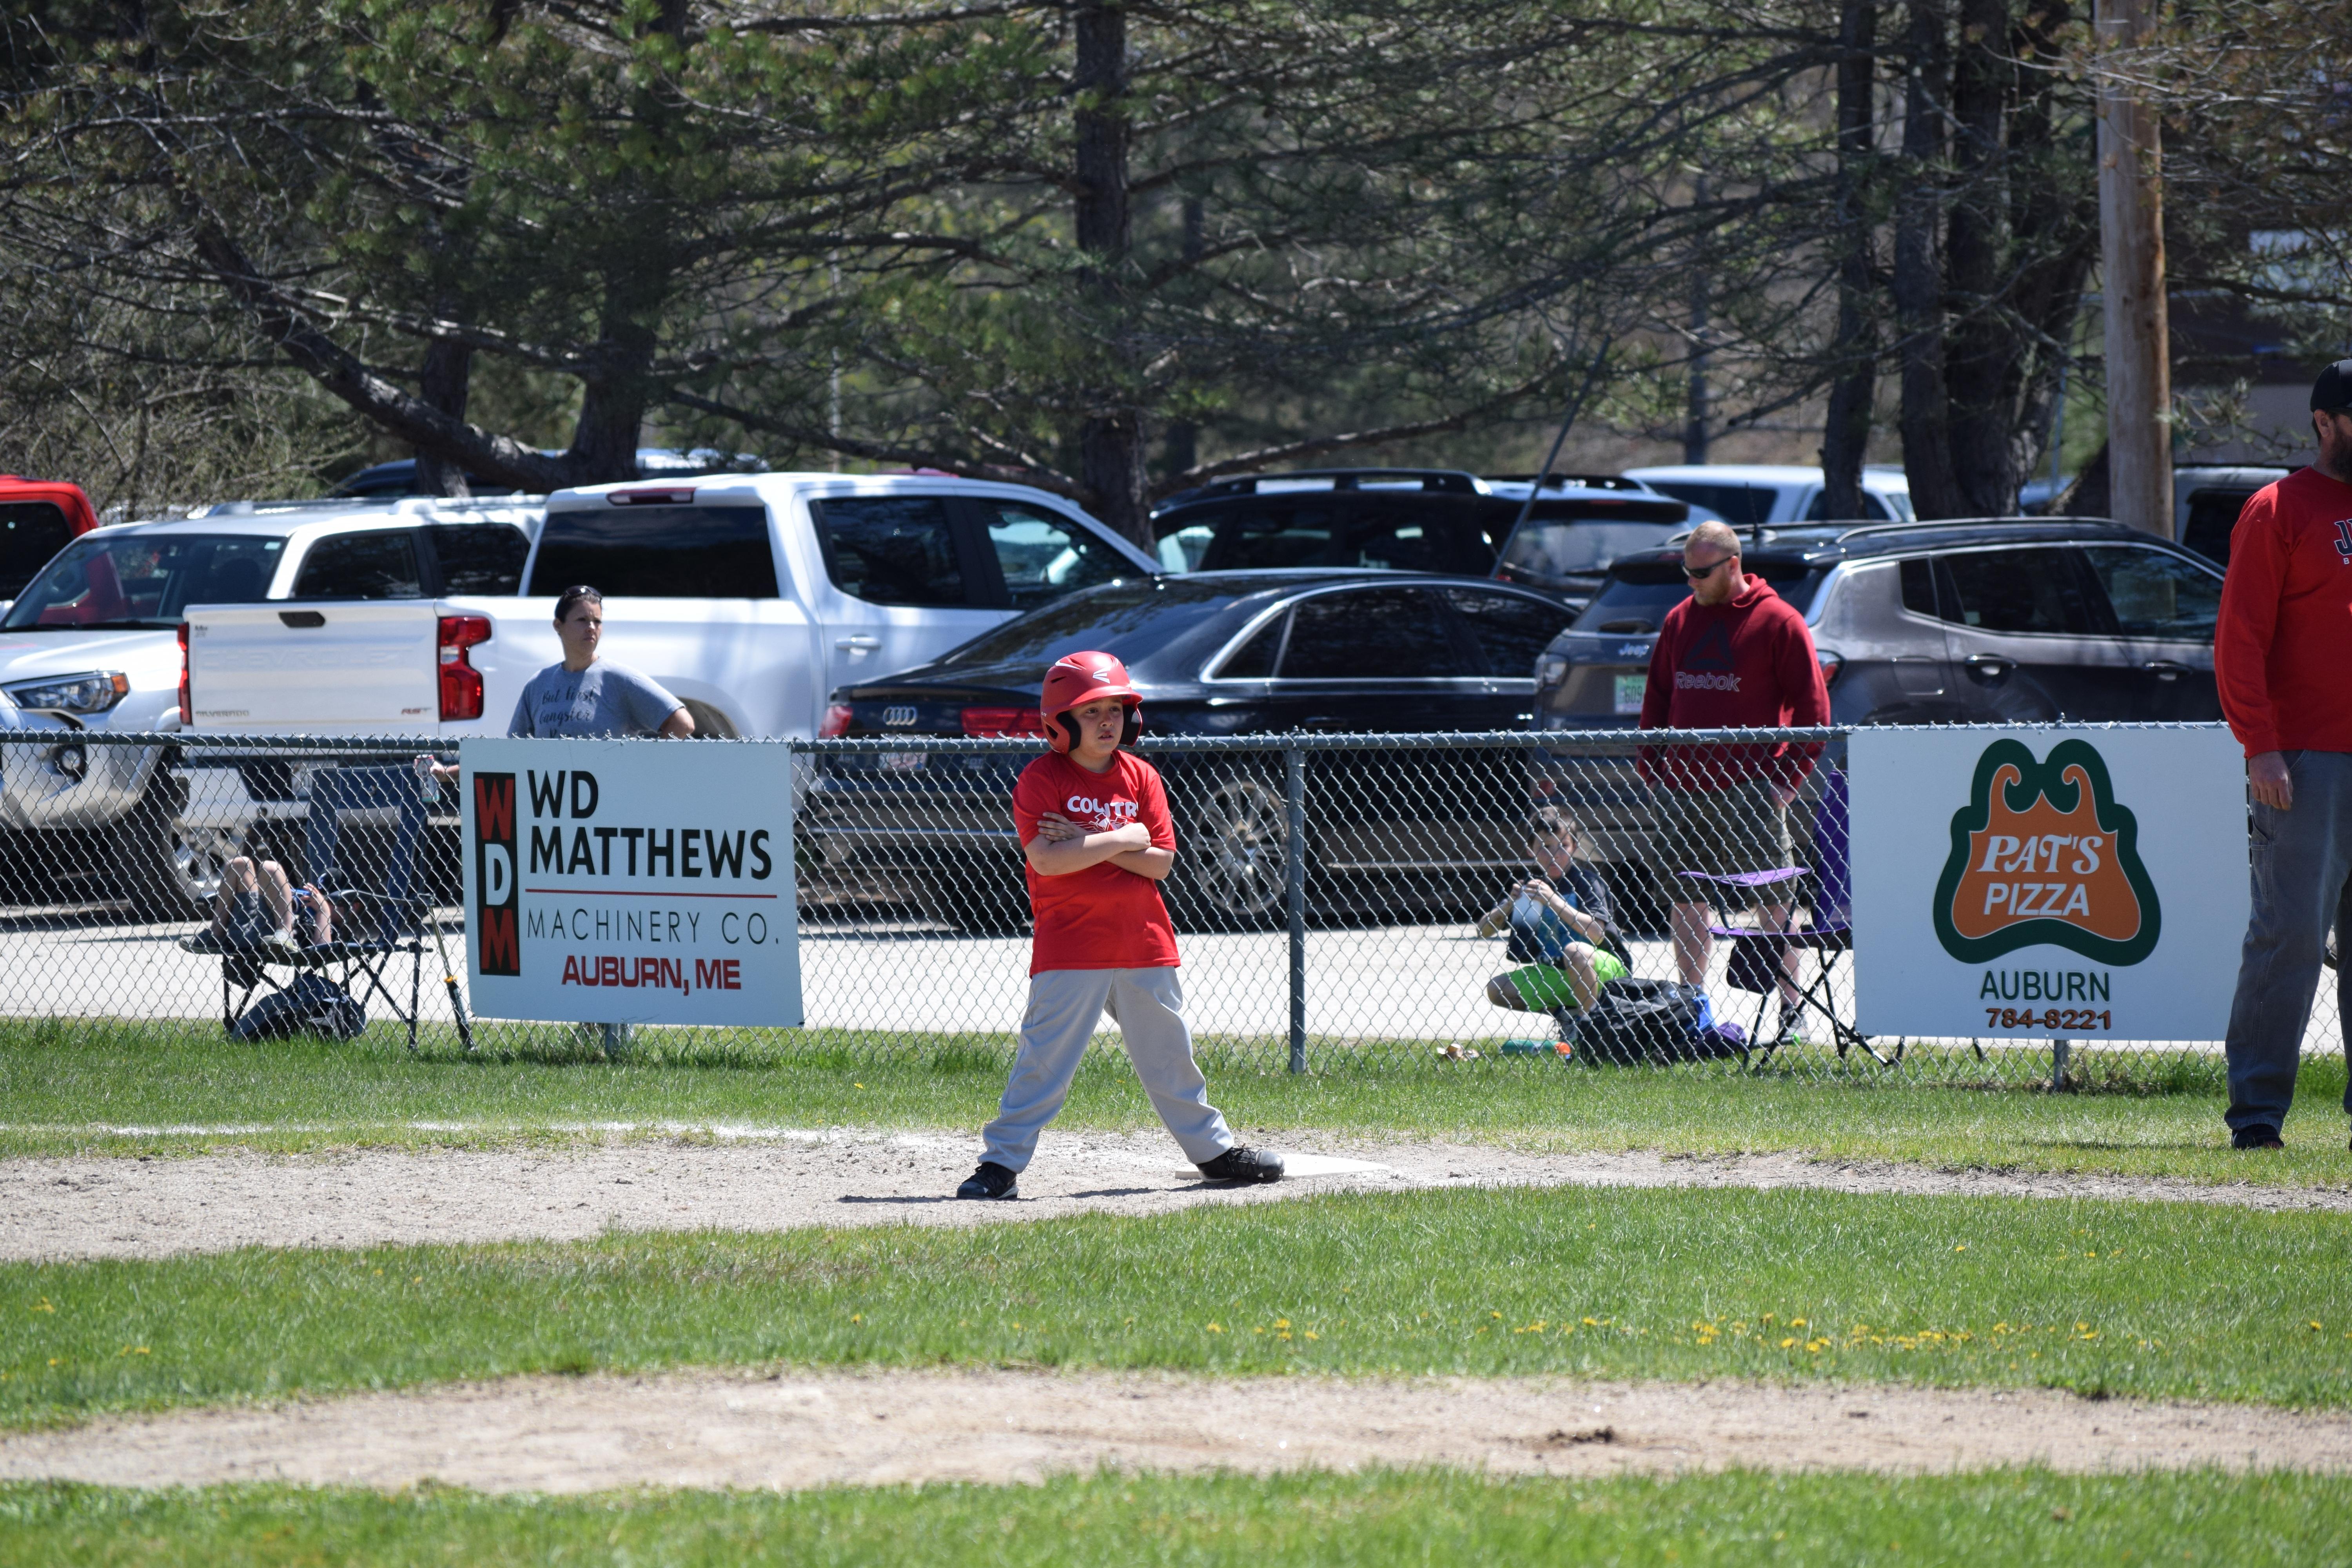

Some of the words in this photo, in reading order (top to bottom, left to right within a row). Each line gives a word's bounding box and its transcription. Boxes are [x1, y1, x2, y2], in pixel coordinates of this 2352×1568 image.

[1618, 643, 1650, 658] Jeep
[542, 689, 561, 704] But
[1676, 672, 1741, 691] Reebok
[539, 707, 592, 726] Gangster
[527, 770, 599, 819] WD
[530, 825, 772, 880] MATTHEWS
[1976, 833, 2103, 875] PAT'S
[475, 779, 519, 970] WDM
[1983, 883, 2090, 916] PIZZA
[528, 908, 700, 943] MACHINERY
[721, 912, 779, 945] CO.
[561, 955, 690, 996] AUBURN,
[695, 959, 741, 990] ME
[1980, 970, 2111, 1002] AUBURN
[1986, 1007, 2112, 1030] 784-8221
